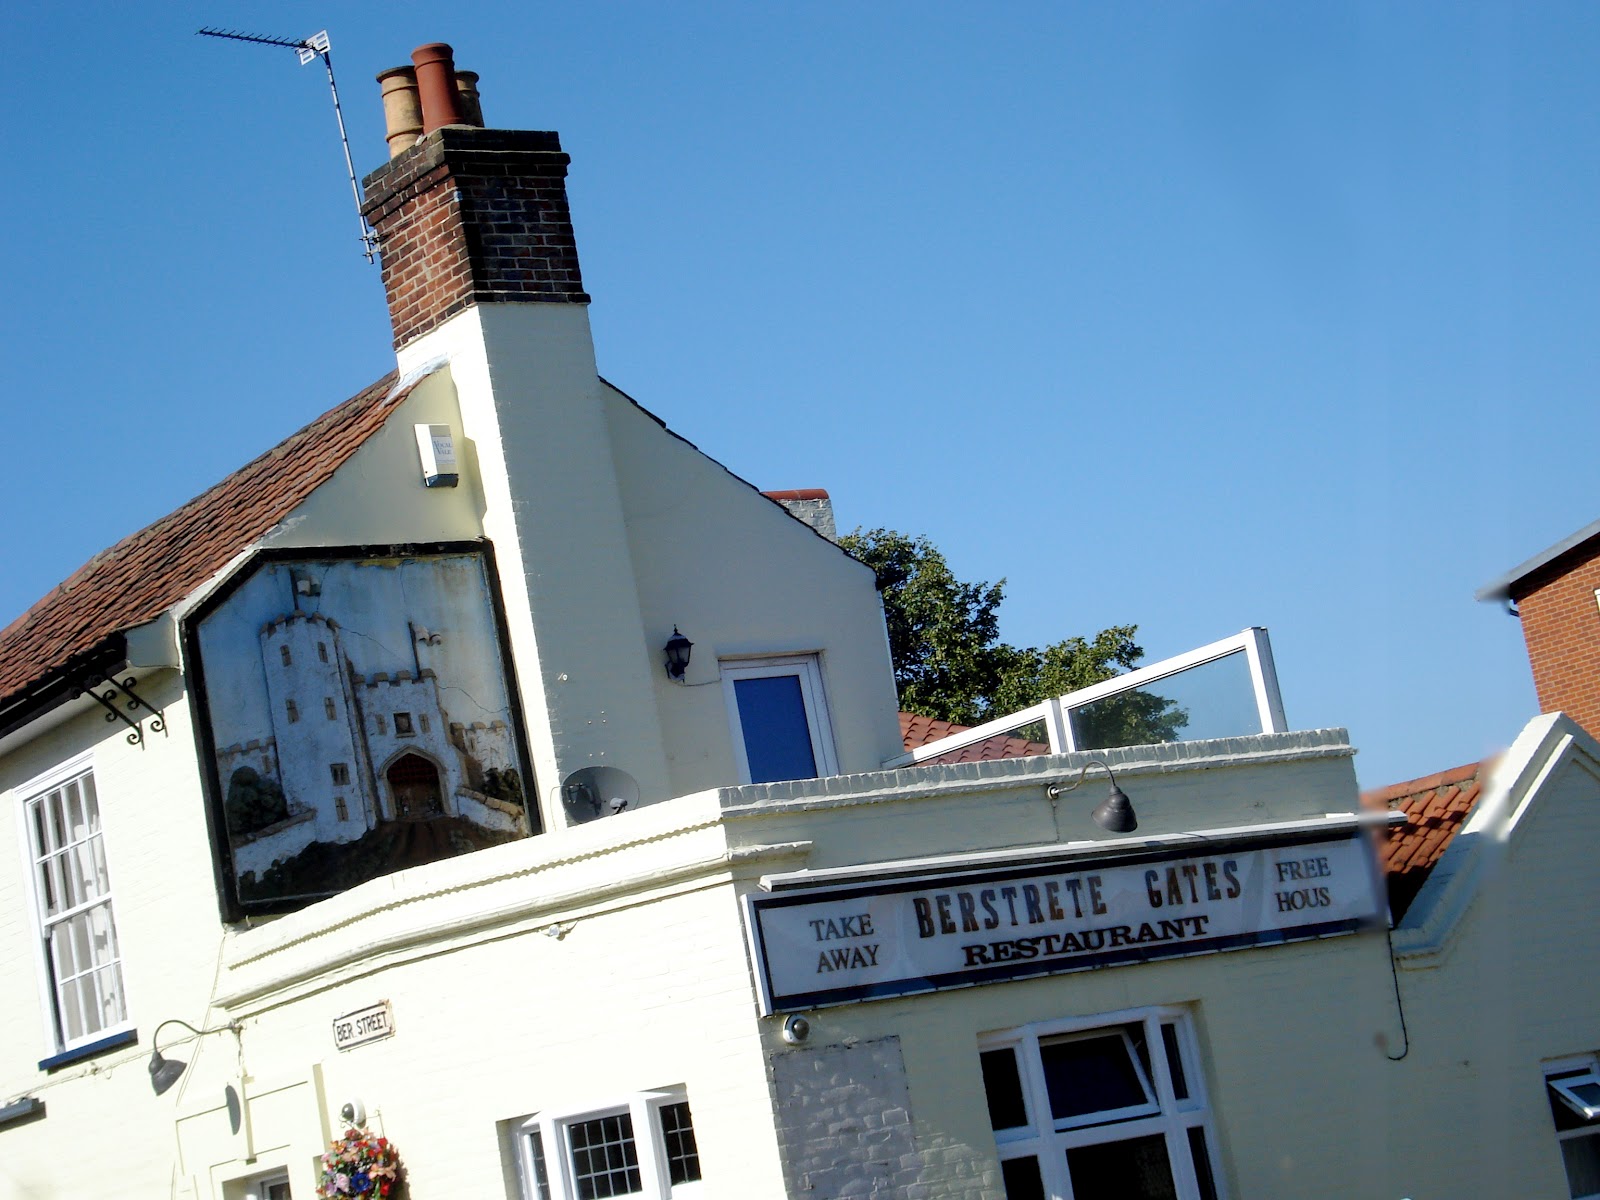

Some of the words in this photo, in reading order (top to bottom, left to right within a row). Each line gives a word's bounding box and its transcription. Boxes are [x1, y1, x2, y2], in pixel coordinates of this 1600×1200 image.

[1275, 857, 1331, 882] FREE
[912, 875, 1107, 938] BERSTRETE
[1145, 860, 1241, 908] GATES
[1275, 887, 1331, 912] HOUS
[809, 913, 875, 941] TAKE
[961, 915, 1209, 967] RESTAURANT
[816, 944, 880, 974] AWAY
[336, 1022, 354, 1042] BER
[356, 1010, 388, 1035] STREET
